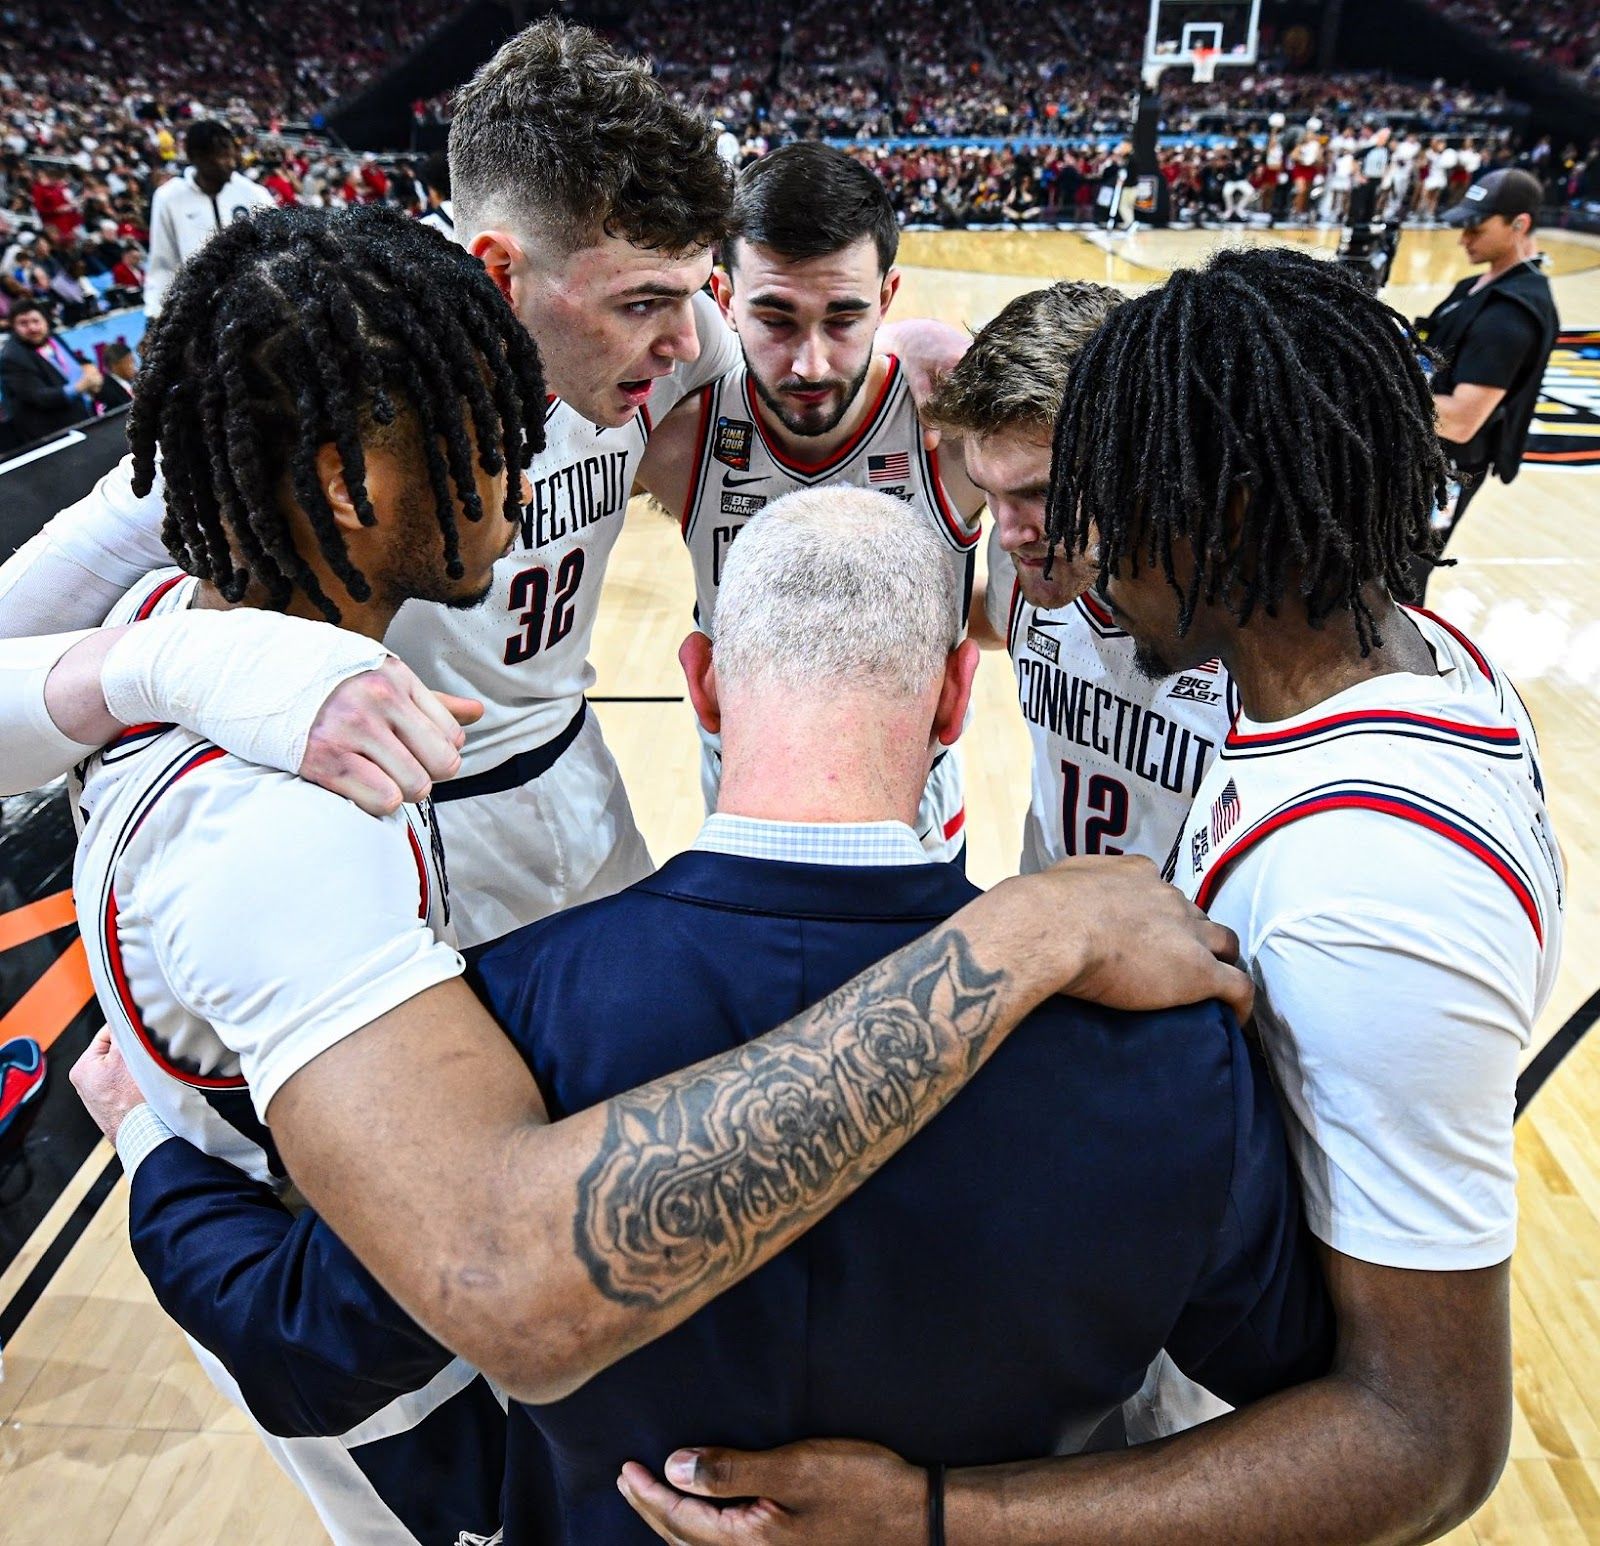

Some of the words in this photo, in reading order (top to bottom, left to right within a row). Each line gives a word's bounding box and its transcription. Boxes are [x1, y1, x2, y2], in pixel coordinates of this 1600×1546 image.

[721, 427, 746, 440] FINAL
[720, 437, 745, 450] FOUR
[511, 450, 629, 550] NECTICUT
[731, 495, 751, 506] BE
[722, 504, 758, 515] CHANG
[503, 547, 585, 666] 32
[1177, 675, 1214, 690] BIG
[1171, 685, 1222, 701] EAST
[1019, 658, 1214, 798] CONNECTICUT
[1061, 759, 1129, 857] 12
